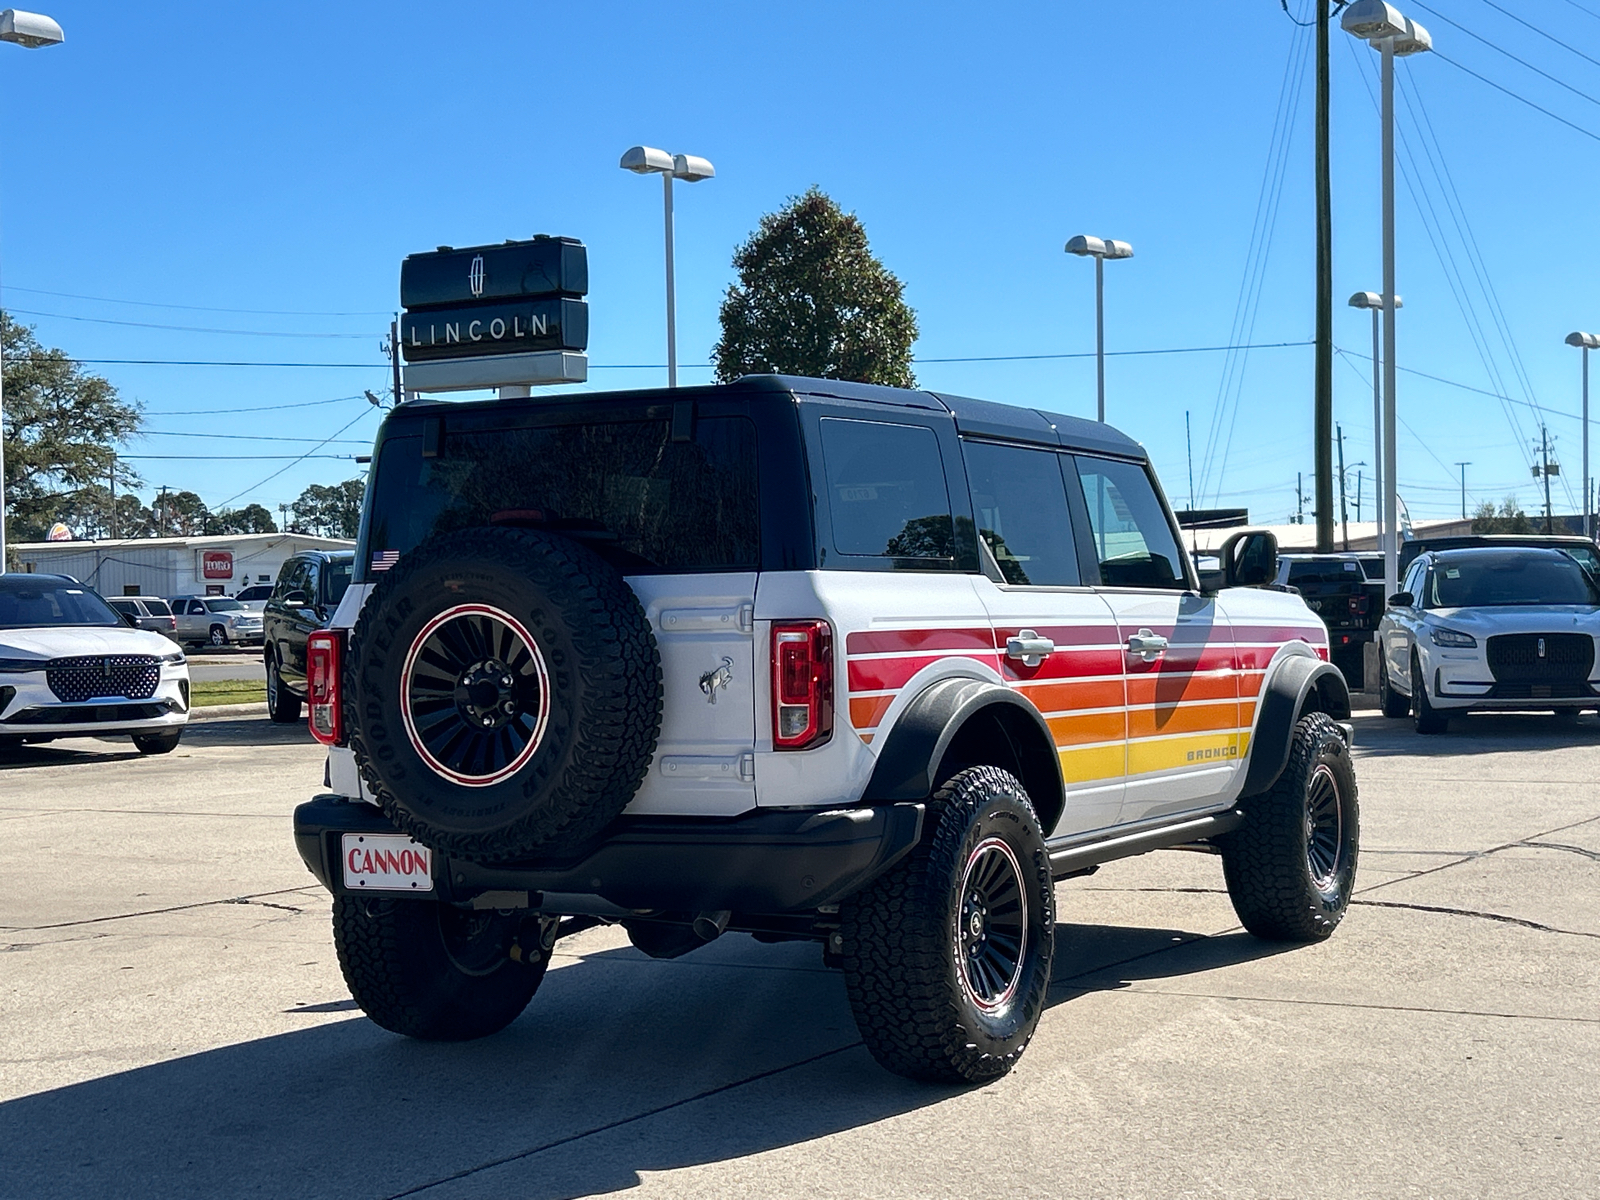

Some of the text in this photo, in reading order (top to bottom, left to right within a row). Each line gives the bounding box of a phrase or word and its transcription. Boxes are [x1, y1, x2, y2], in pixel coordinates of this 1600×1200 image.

[411, 313, 548, 347] LINCOLN
[205, 560, 231, 571] TORO
[1187, 746, 1237, 761] BRONCO
[348, 848, 428, 875] CANNON
